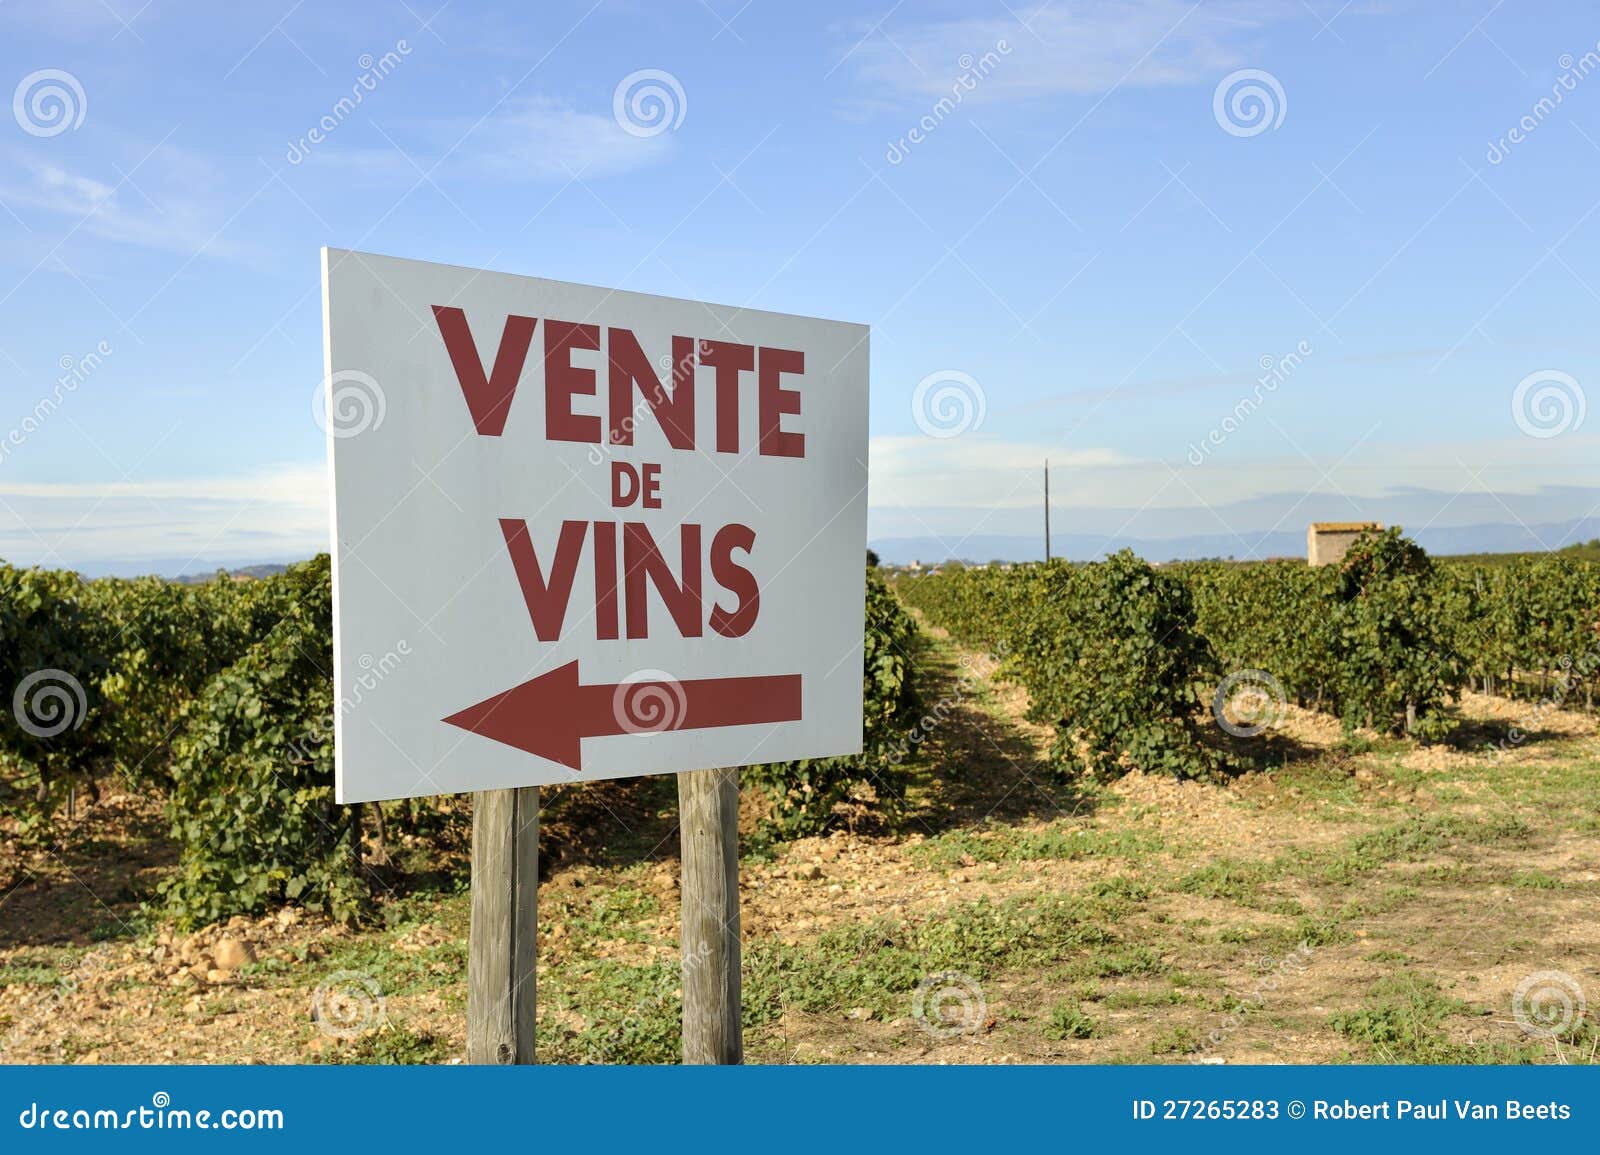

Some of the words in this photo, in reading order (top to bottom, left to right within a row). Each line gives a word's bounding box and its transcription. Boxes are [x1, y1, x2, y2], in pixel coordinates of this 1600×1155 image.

[432, 305, 806, 458] VENTE
[611, 461, 662, 509] DE
[499, 518, 760, 642] VINS
